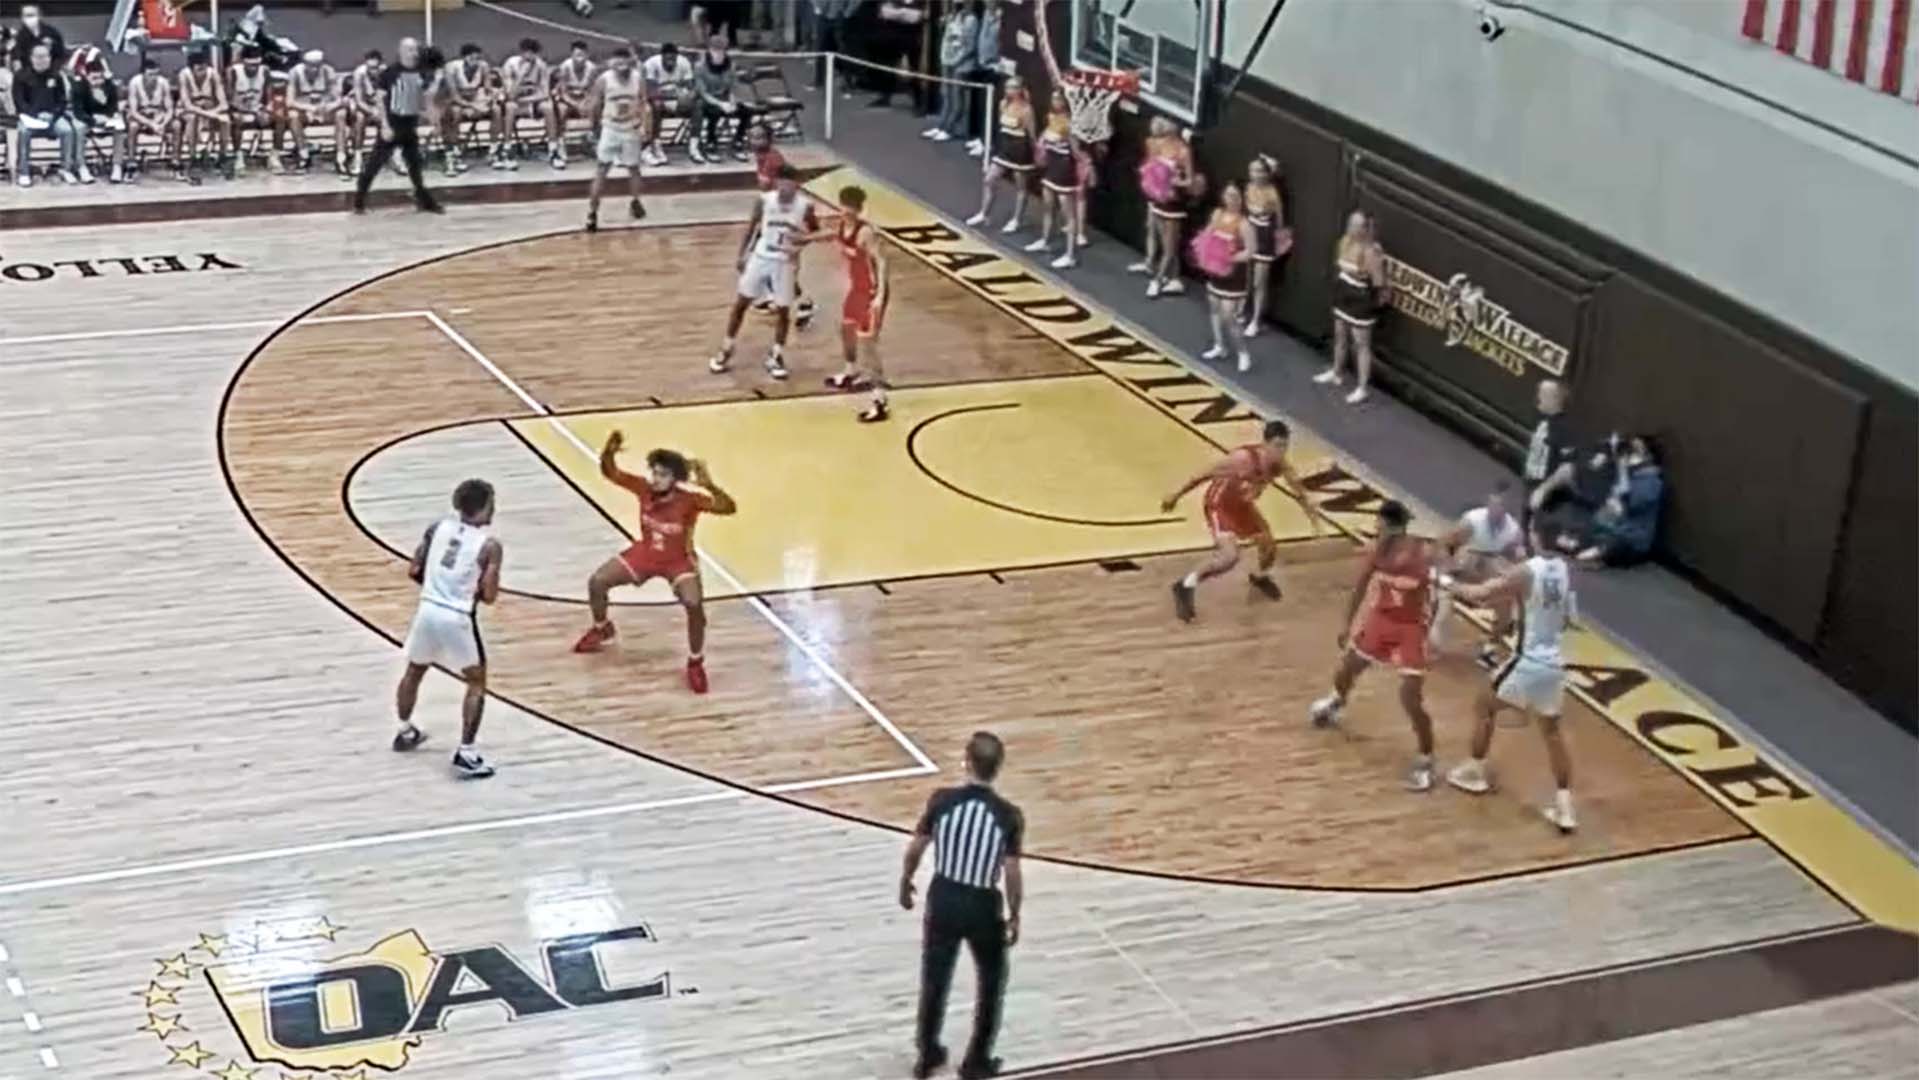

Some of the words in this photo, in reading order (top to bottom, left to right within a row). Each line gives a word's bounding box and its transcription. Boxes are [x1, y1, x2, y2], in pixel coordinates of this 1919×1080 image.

[0, 252, 246, 283] YELLO
[1472, 298, 1567, 374] WALLACE
[880, 223, 1265, 425] BALDWIN
[1300, 461, 1815, 807] WACE
[264, 925, 669, 1050] OAC
